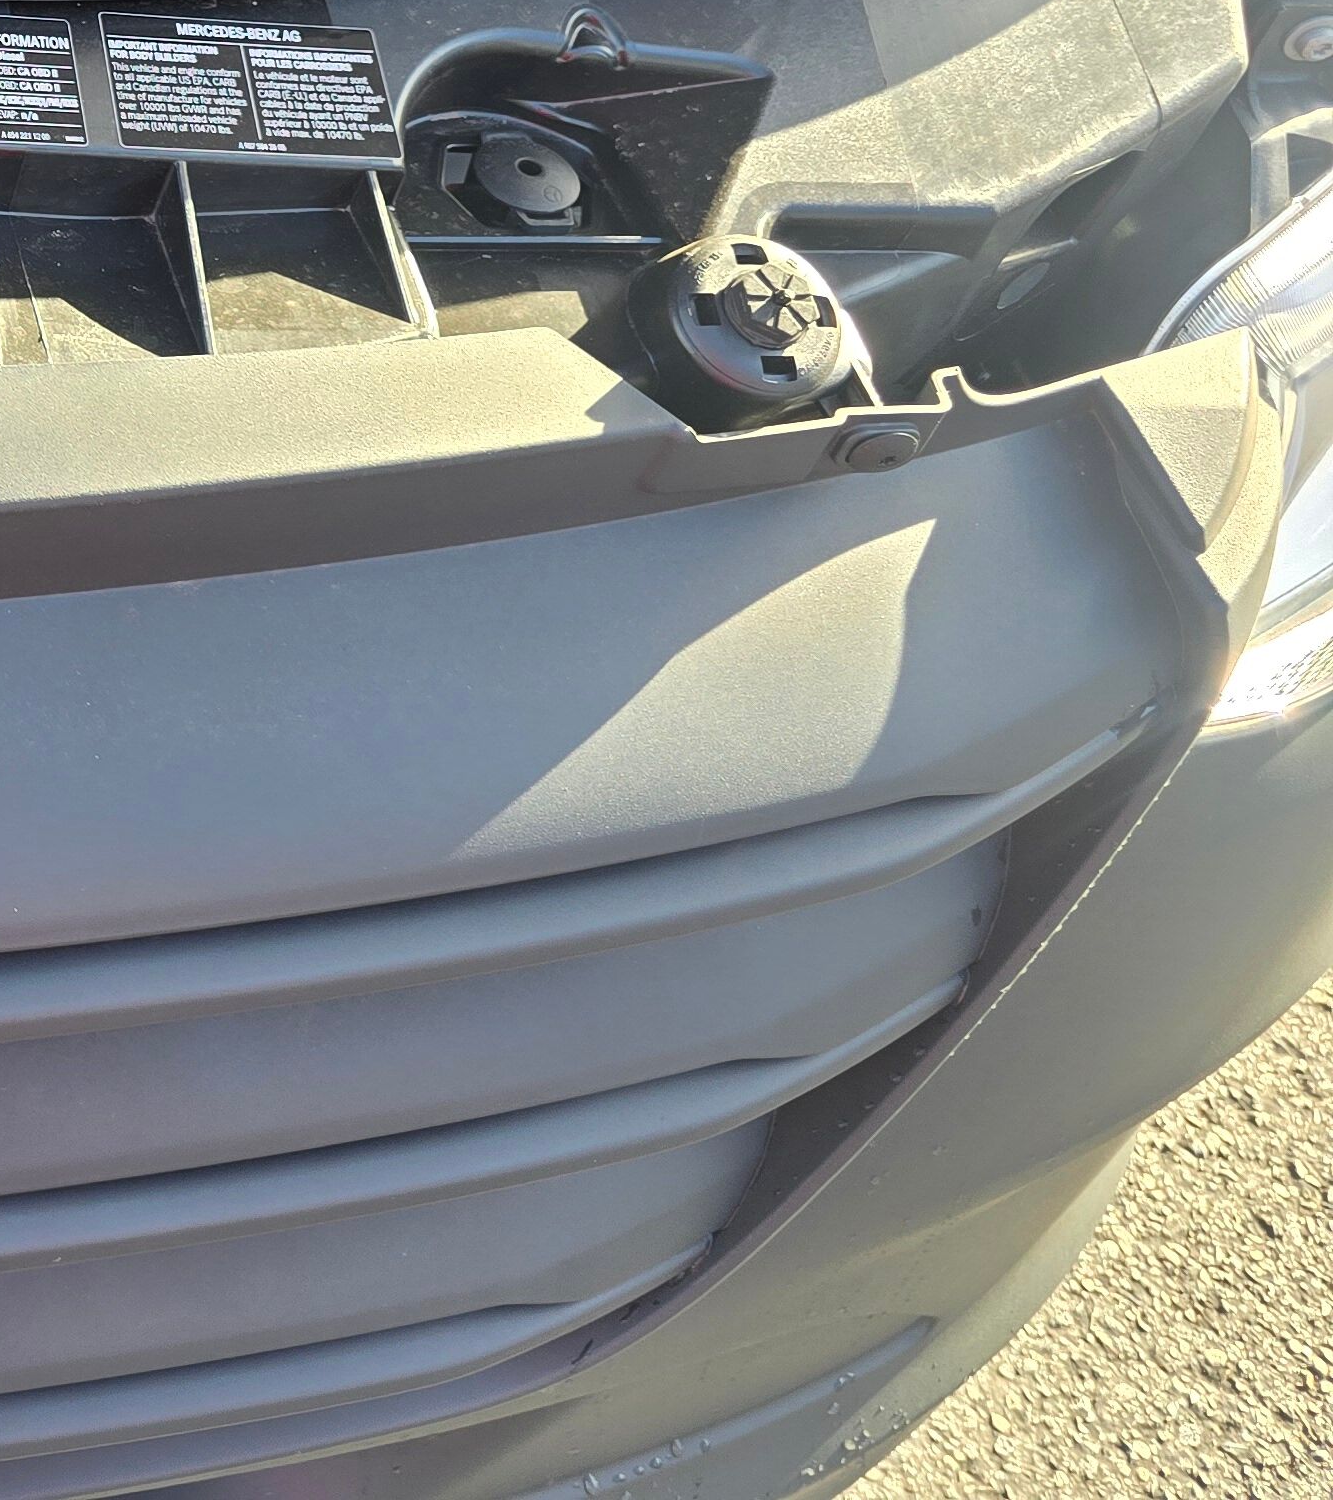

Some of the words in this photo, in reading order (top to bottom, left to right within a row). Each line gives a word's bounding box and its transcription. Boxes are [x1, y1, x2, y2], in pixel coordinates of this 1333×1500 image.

[176, 22, 281, 42] MERCEDES-BENZ
[282, 30, 302, 43] AG
[178, 75, 191, 85] US
[139, 102, 166, 112] 10000
